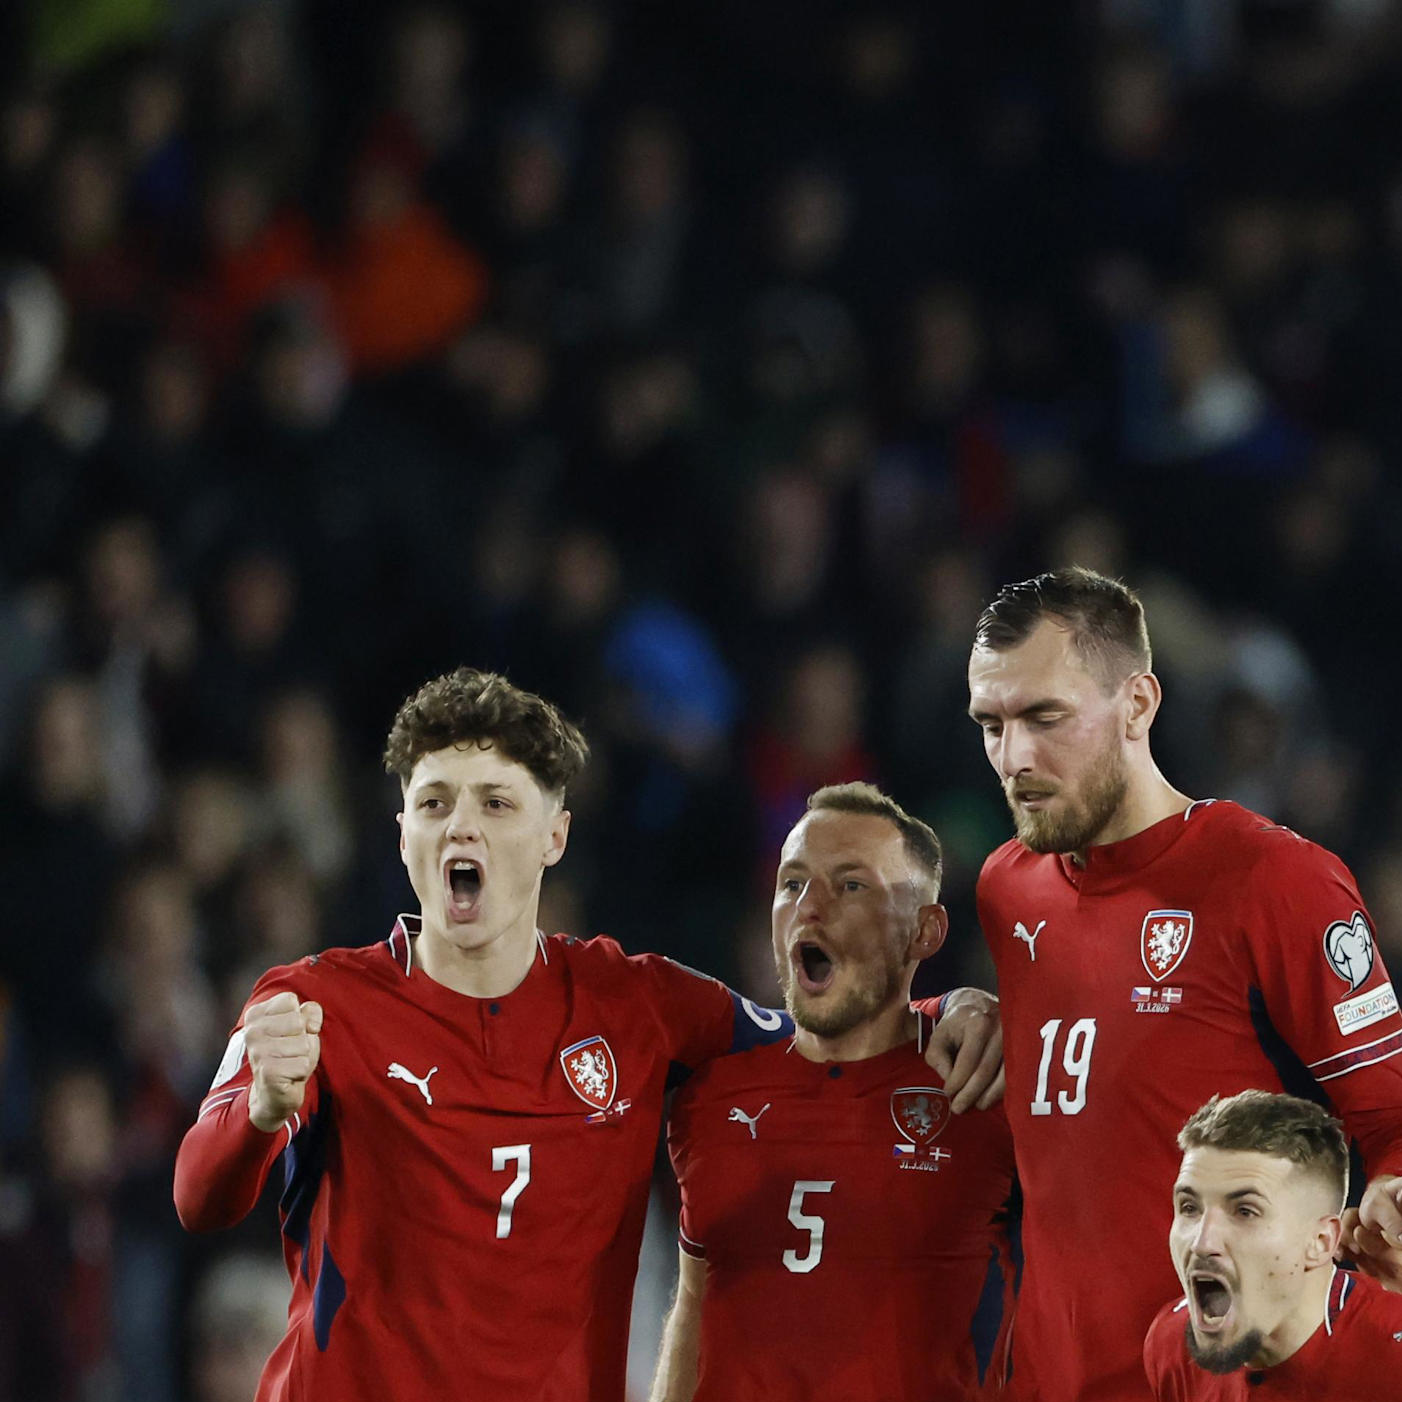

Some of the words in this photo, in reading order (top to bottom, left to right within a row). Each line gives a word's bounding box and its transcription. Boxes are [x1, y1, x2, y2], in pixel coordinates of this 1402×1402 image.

[1338, 992, 1396, 1026] FOUNDATION
[1031, 1018, 1097, 1116] 19
[490, 1143, 531, 1239] 7
[782, 1180, 836, 1274] 5
